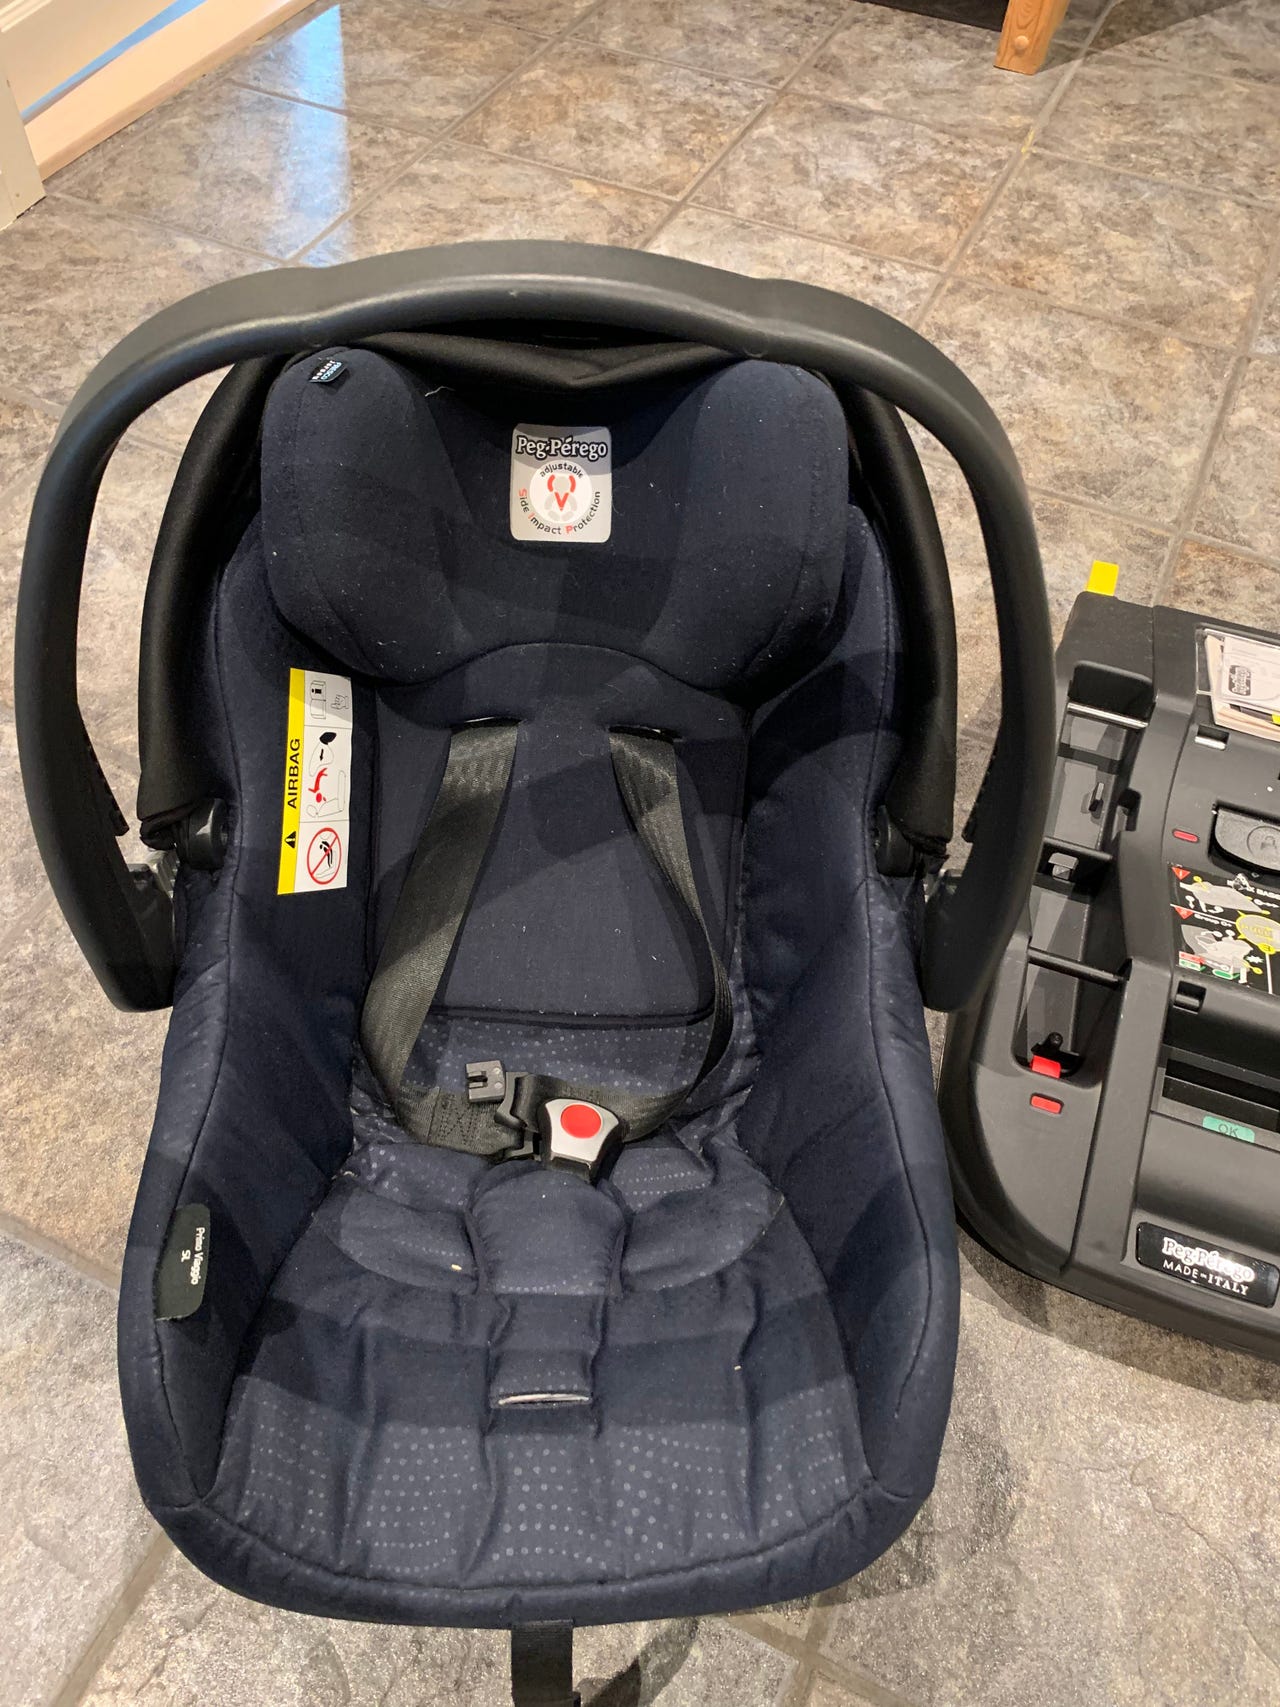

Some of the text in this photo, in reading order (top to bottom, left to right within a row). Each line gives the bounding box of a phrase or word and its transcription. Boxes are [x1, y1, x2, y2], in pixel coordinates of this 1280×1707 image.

[540, 462, 584, 479] adjustable
[518, 487, 601, 535] Side Impact Protection
[287, 738, 301, 809] AIRBAG
[1218, 1124, 1239, 1139] OK
[180, 1249, 192, 1263] SL
[190, 1227, 206, 1286] Primo Viaggio
[1163, 1259, 1249, 1296] MADE ITALY
